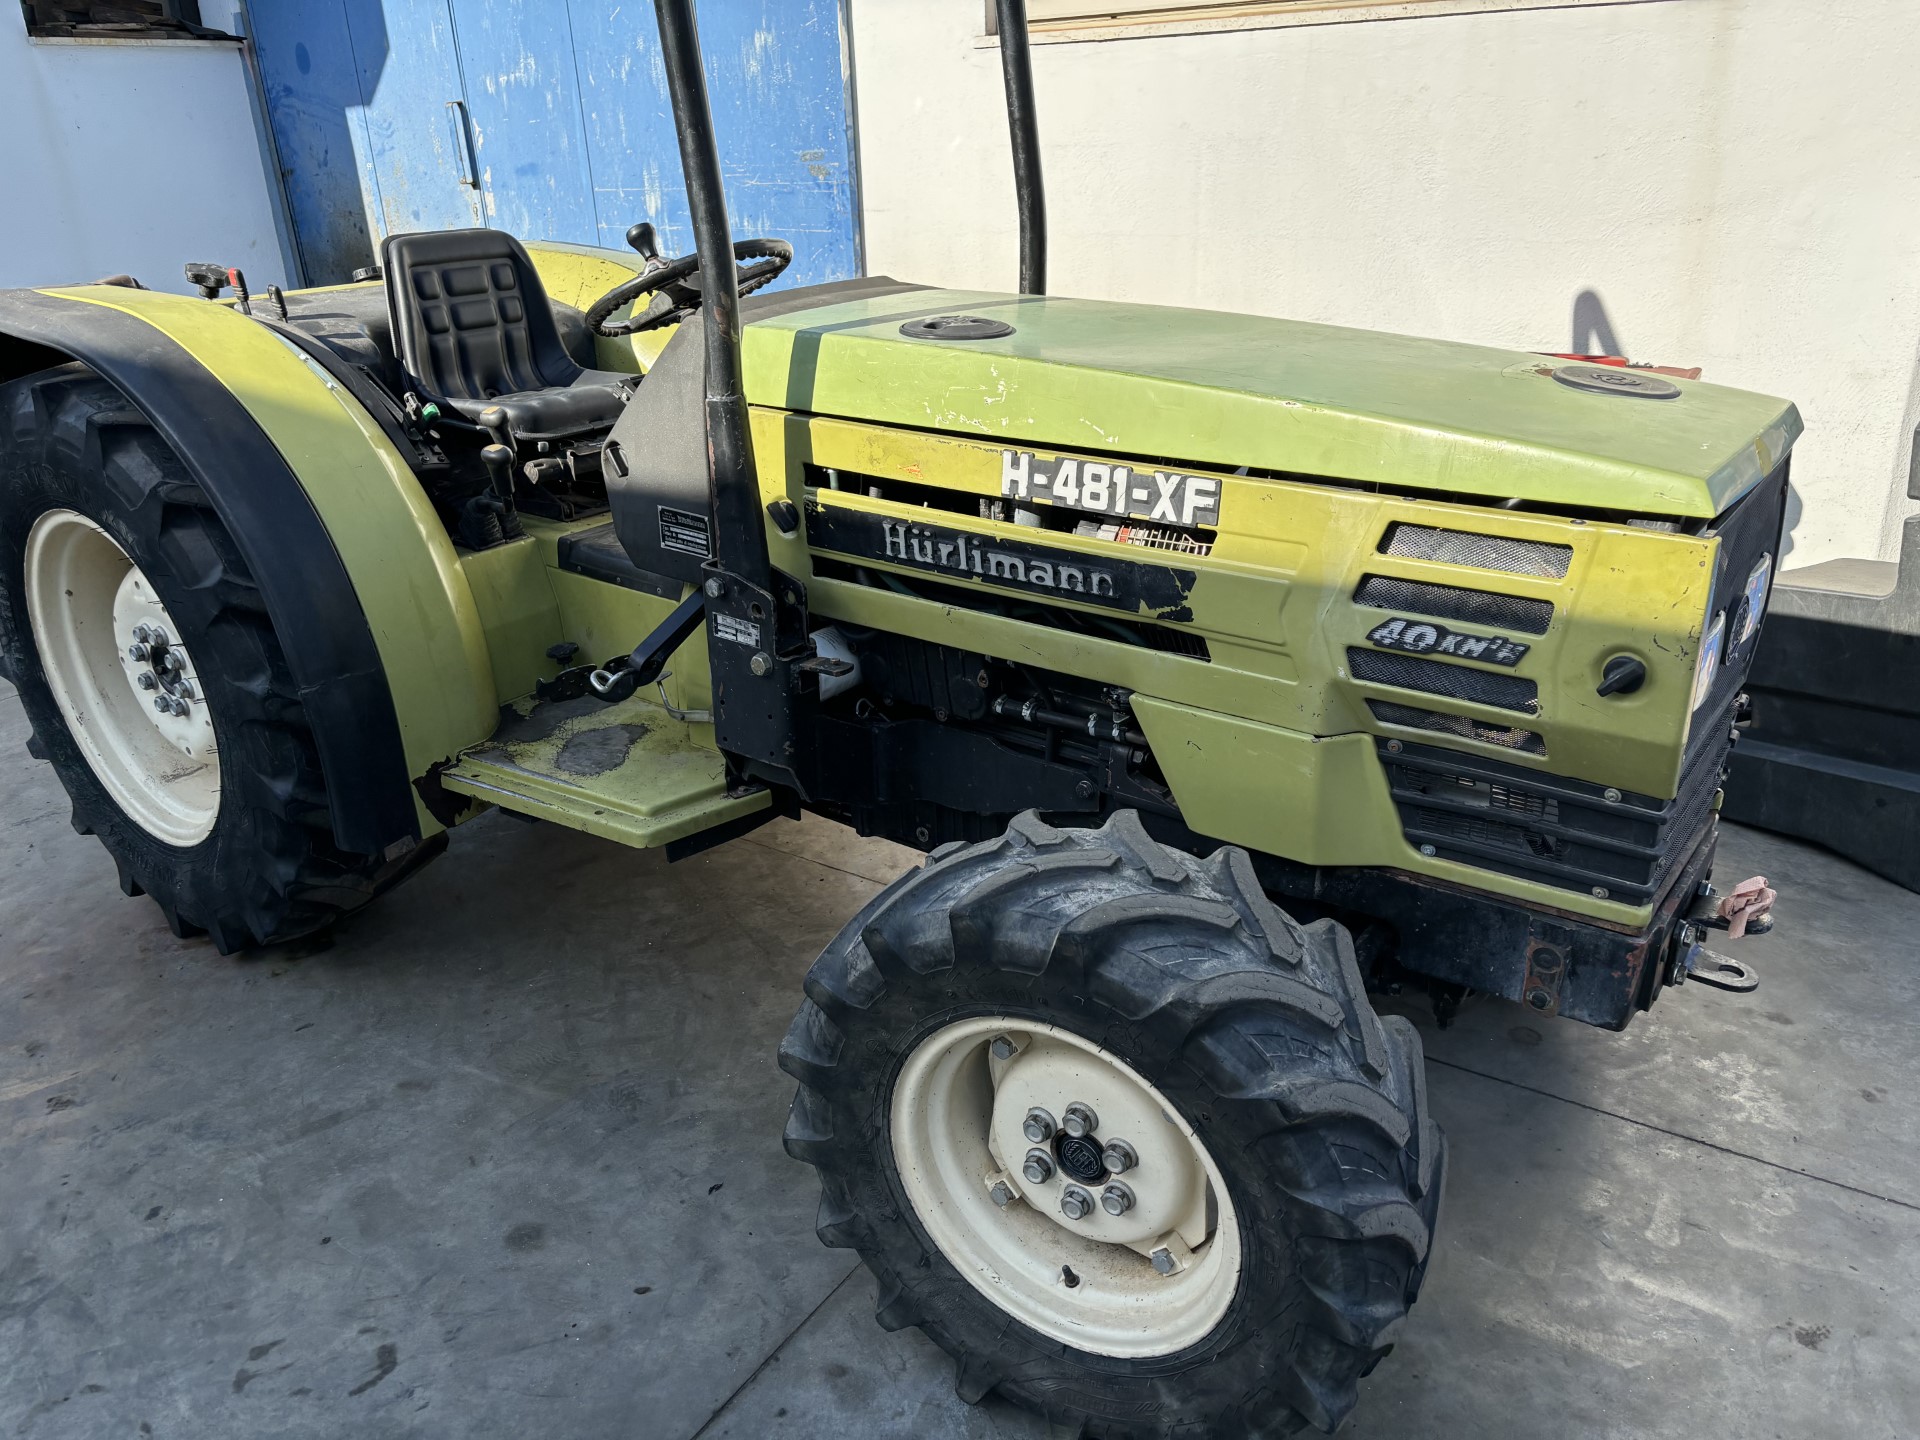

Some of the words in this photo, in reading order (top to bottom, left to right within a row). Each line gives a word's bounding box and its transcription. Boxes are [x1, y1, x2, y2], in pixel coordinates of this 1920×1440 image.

[1001, 449, 1218, 524] H-481-XF
[882, 520, 1116, 597] Hürlimann
[1371, 619, 1438, 650] 40
